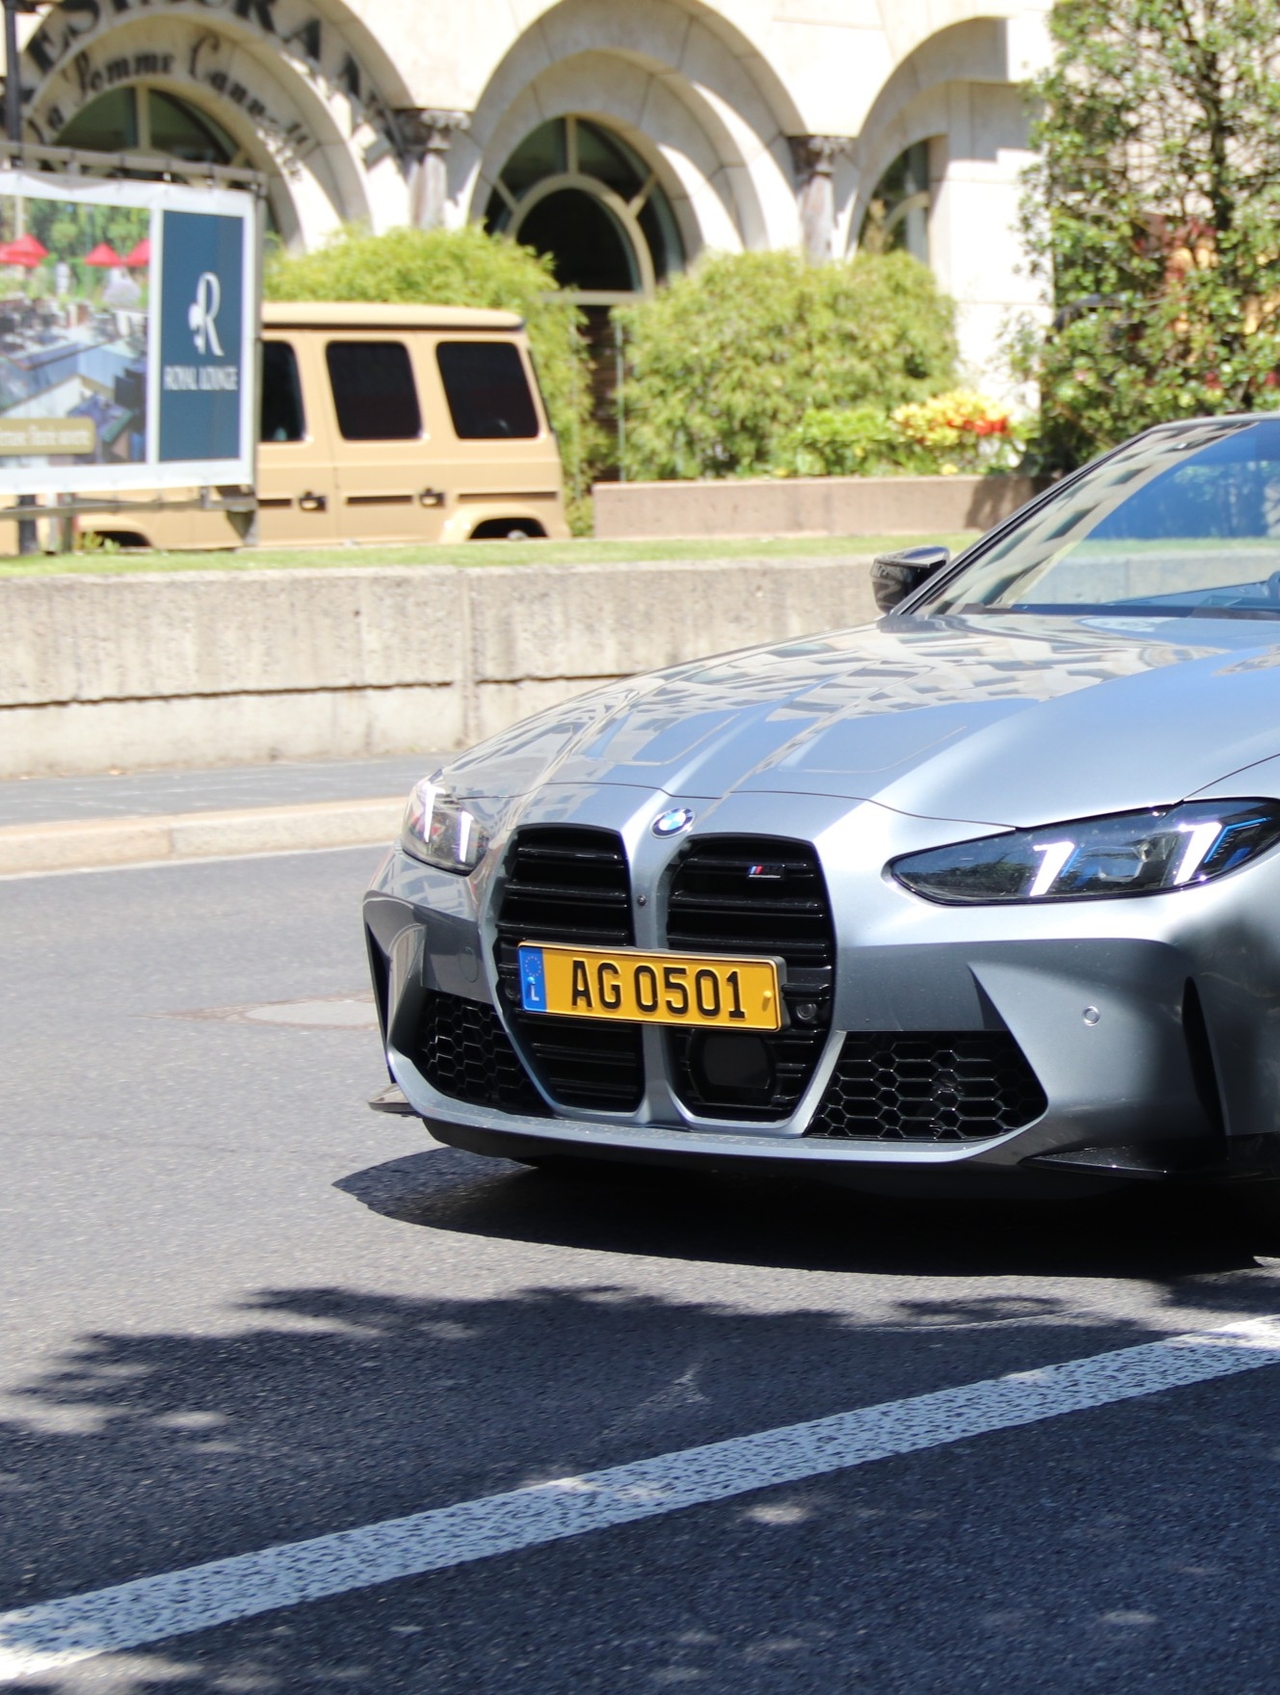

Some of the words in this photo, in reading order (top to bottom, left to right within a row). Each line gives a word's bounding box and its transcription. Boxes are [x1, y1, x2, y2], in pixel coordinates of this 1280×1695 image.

[163, 365, 198, 391] ROYAL
[199, 365, 239, 391] LOUNGE
[571, 960, 622, 1010] AG
[633, 964, 746, 1019] 0501
